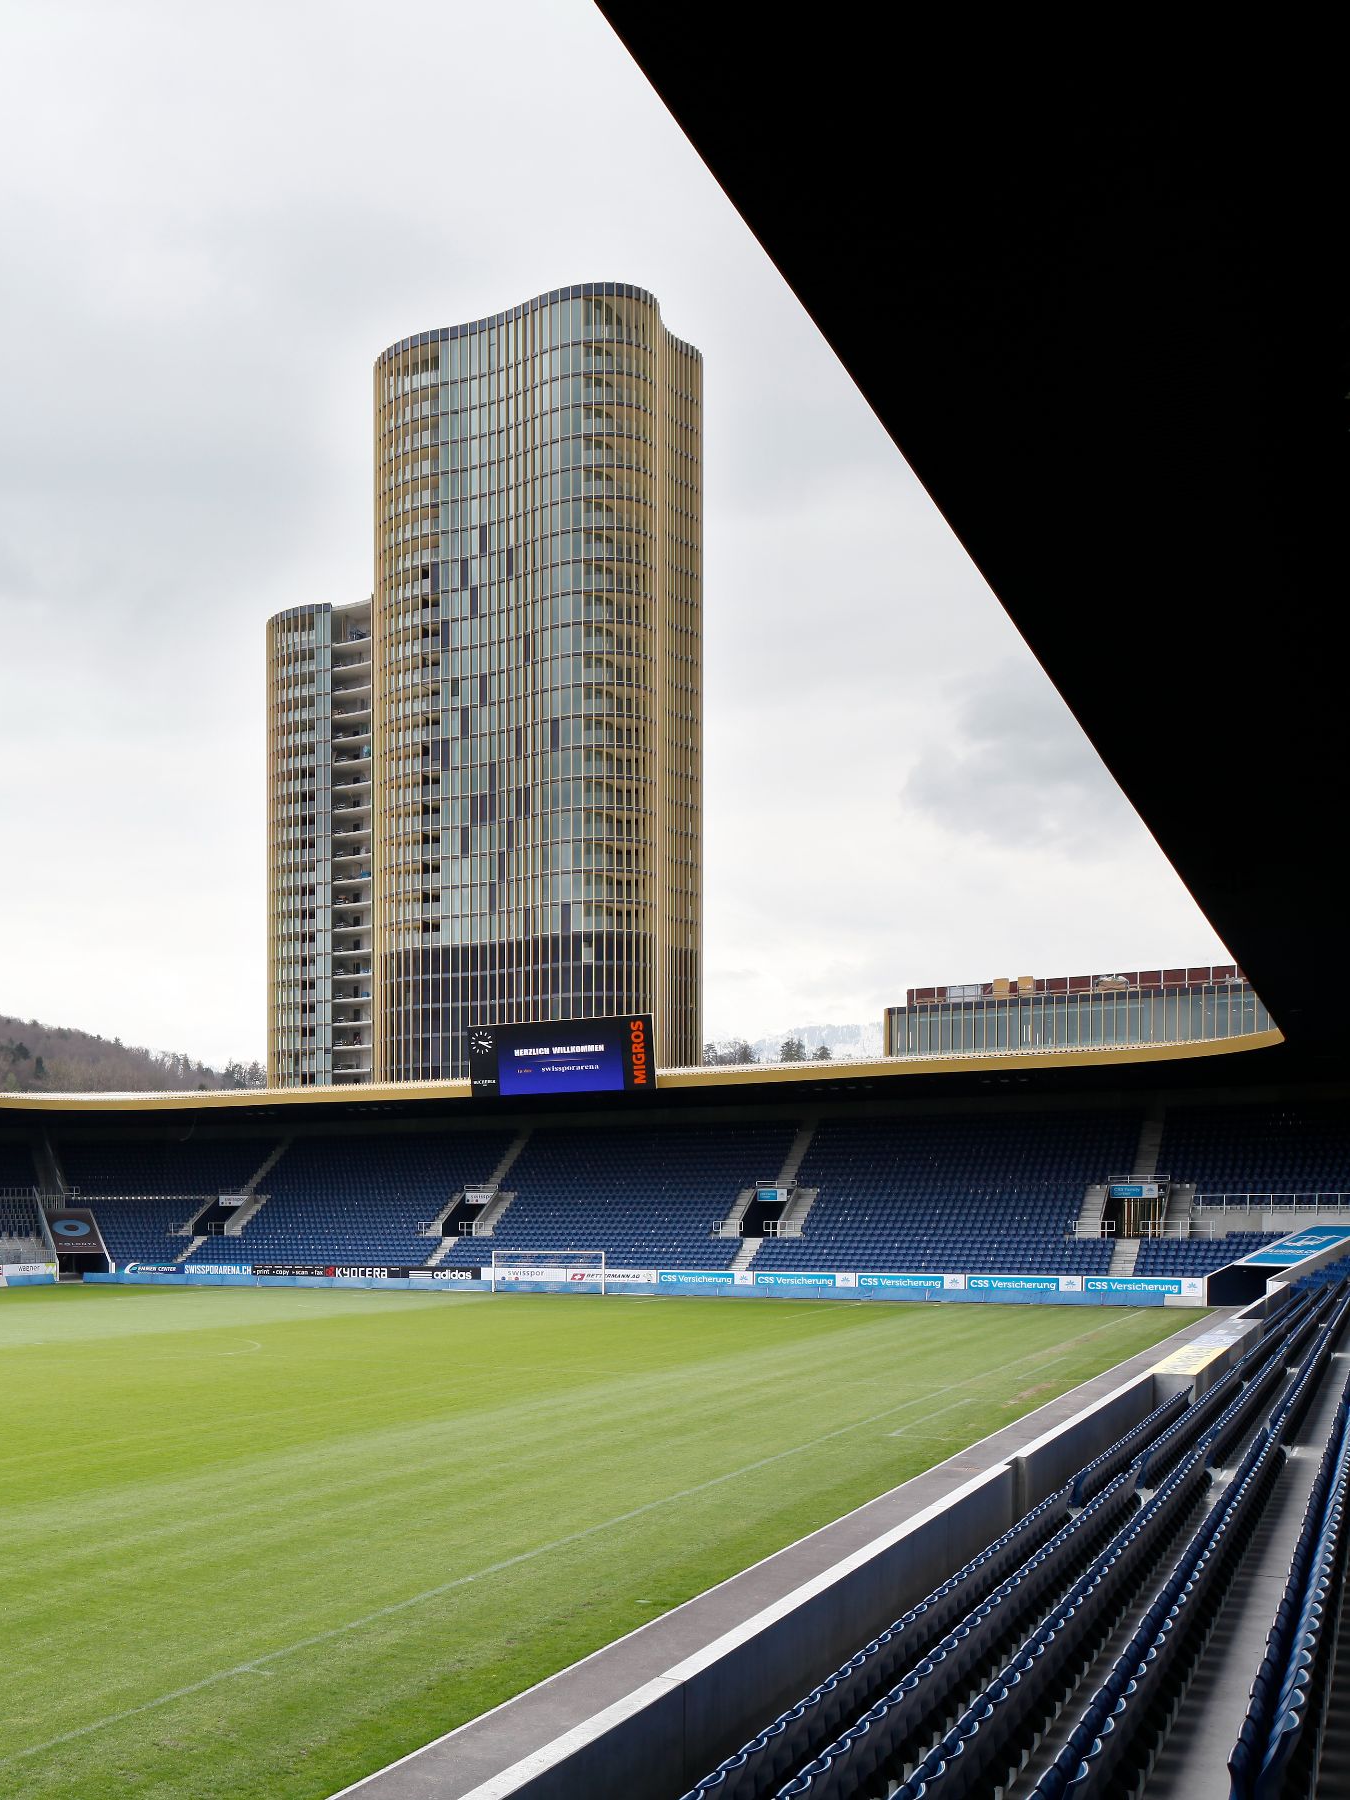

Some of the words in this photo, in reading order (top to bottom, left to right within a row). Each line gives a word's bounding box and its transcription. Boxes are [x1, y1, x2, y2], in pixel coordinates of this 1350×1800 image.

[513, 1047, 550, 1057] HERZLICH
[551, 1044, 605, 1055] WILLKOMMEN
[630, 1019, 648, 1085] MIGROS
[541, 1064, 600, 1073] swissporarena
[184, 1264, 252, 1275] SWISSPORARENA.CH
[335, 1267, 388, 1279] KYOCERA
[433, 1269, 472, 1280] adidas
[507, 1269, 545, 1278] swisspor
[660, 1274, 677, 1283] CSS
[678, 1274, 732, 1284] Versicherung
[757, 1276, 775, 1285] CSS
[776, 1276, 833, 1287] Versicherung
[860, 1277, 878, 1286] CSS
[879, 1277, 941, 1289] Versicherung
[970, 1279, 989, 1288] CSS
[990, 1279, 1057, 1290] Versicherung
[1087, 1281, 1109, 1290] CSS
[1109, 1281, 1179, 1293] Versicherung
